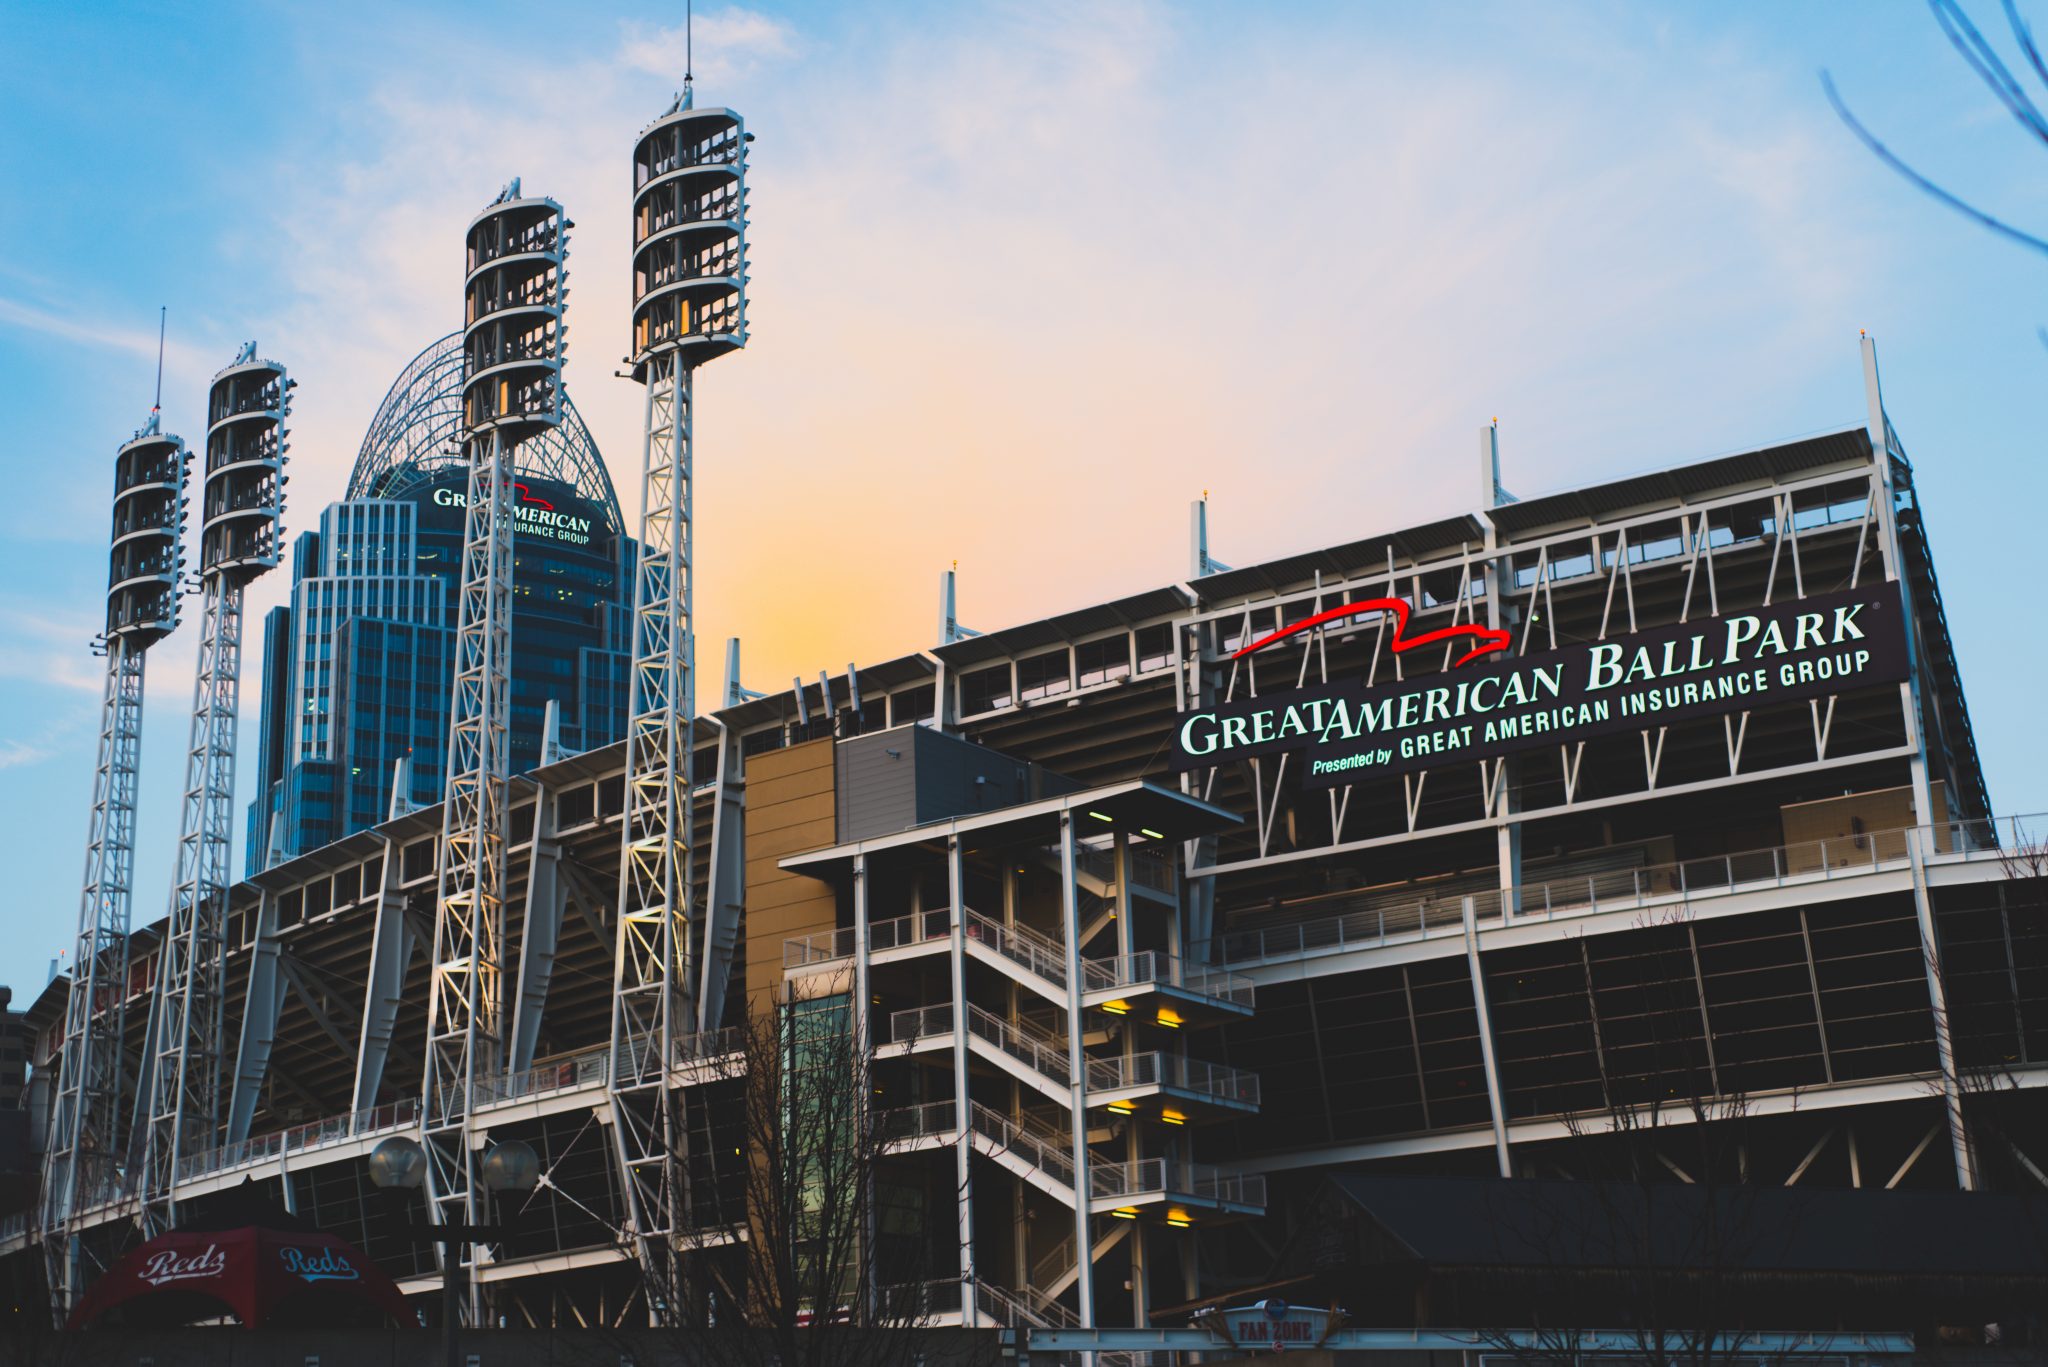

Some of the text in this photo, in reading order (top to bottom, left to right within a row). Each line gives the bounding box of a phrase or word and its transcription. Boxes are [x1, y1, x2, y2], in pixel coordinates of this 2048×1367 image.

[497, 504, 591, 533] MERICAN
[558, 529, 590, 545] GROUP
[1584, 634, 1714, 692] BALL
[1721, 603, 1866, 665] PARK
[1312, 649, 1870, 776] Presented by GREAT AMERICAN INSURANCE GROUP
[137, 1243, 225, 1286] Reds
[280, 1246, 359, 1283] Reds
[1239, 1321, 1312, 1341] FAN ZONE
